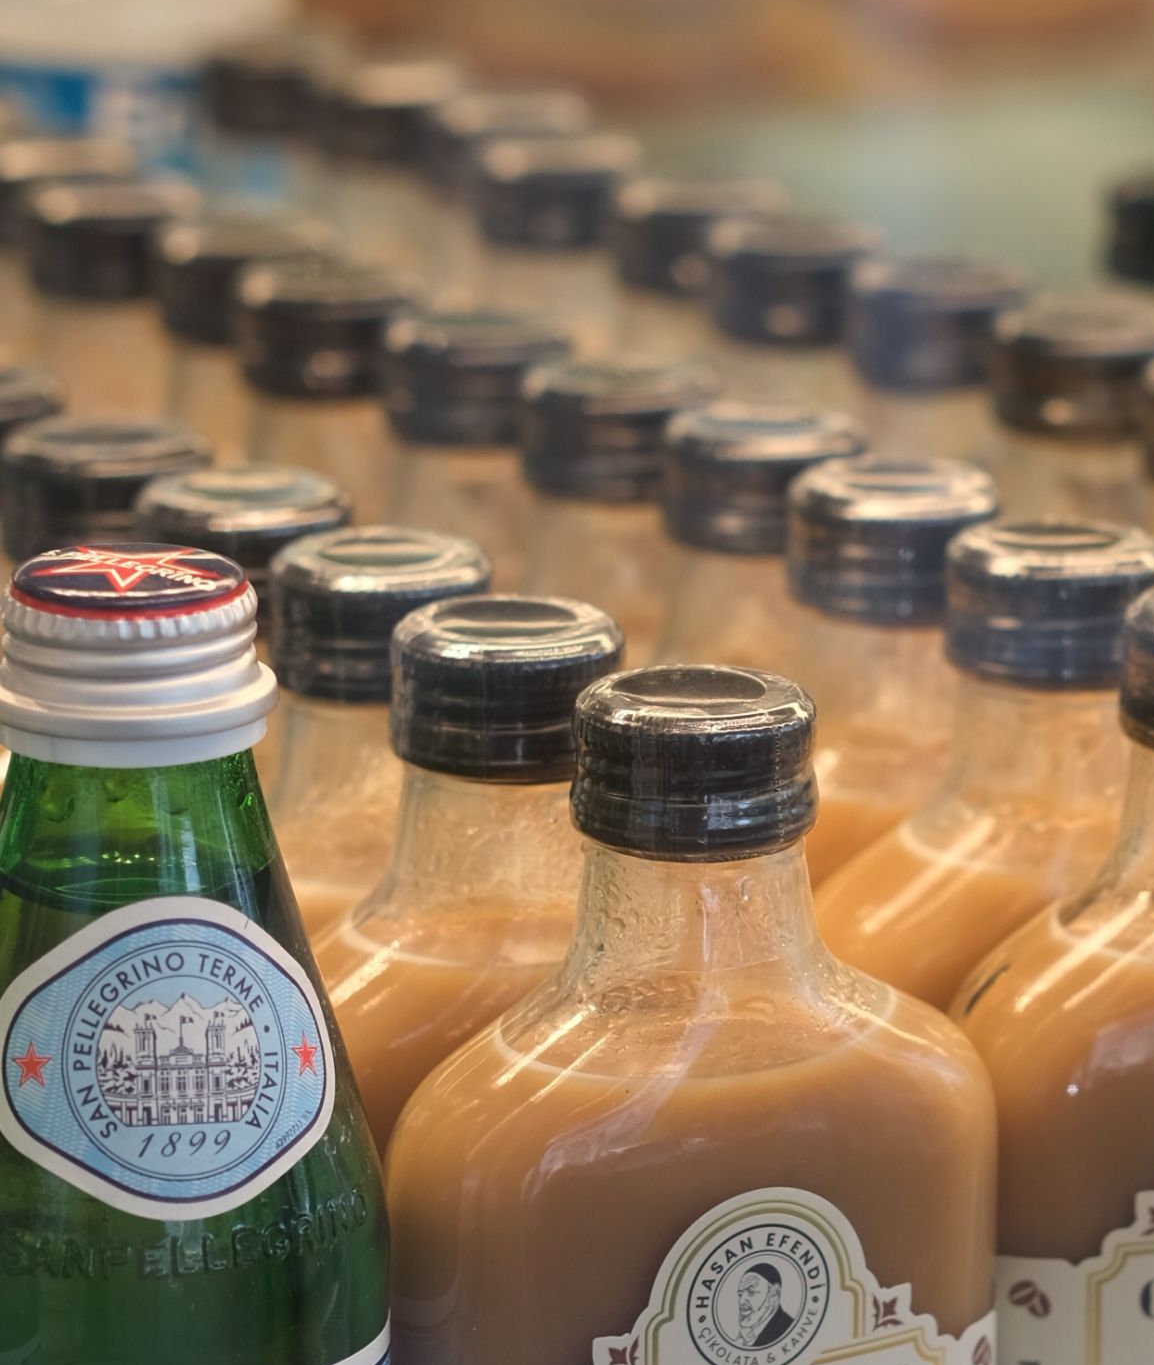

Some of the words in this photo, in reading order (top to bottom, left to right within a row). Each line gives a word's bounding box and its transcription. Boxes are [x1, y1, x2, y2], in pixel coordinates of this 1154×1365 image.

[73, 952, 185, 1072] PELLEGRINO
[199, 953, 264, 1013] TERME
[77, 1085, 118, 1139] SAN
[245, 1051, 279, 1129] ITALIA
[138, 1129, 232, 1158] 1899
[696, 1236, 754, 1309] HASAN
[766, 1352, 777, 1364] &
[781, 1308, 818, 1355] KAHVE
